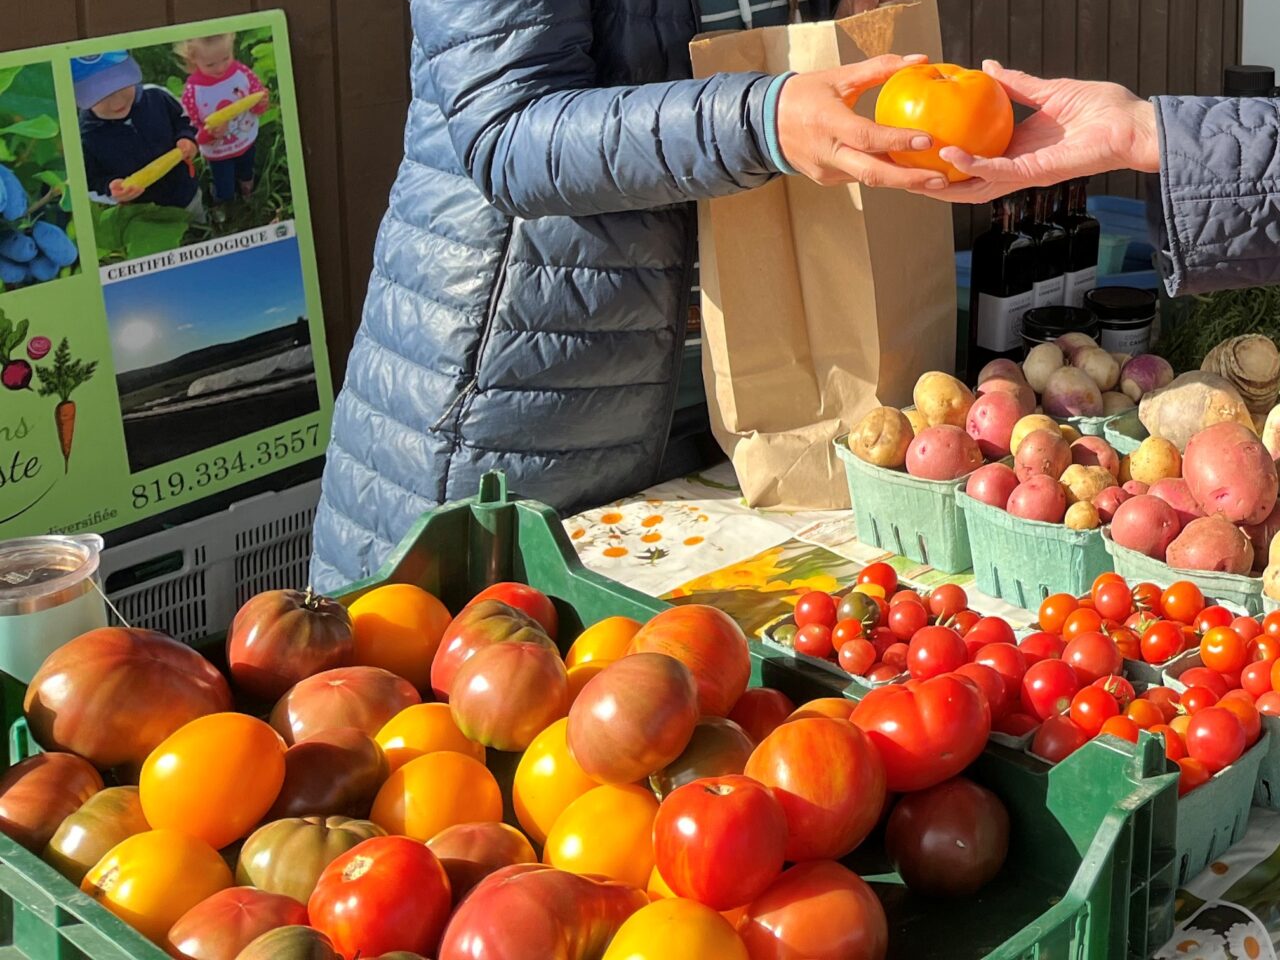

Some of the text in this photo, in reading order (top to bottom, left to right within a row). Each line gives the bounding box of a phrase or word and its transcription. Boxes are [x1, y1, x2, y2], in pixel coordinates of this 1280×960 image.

[107, 252, 176, 280] CERTIFIÉ
[179, 231, 267, 262] BIOLOGIQUE
[131, 423, 320, 509] 819.334.3557
